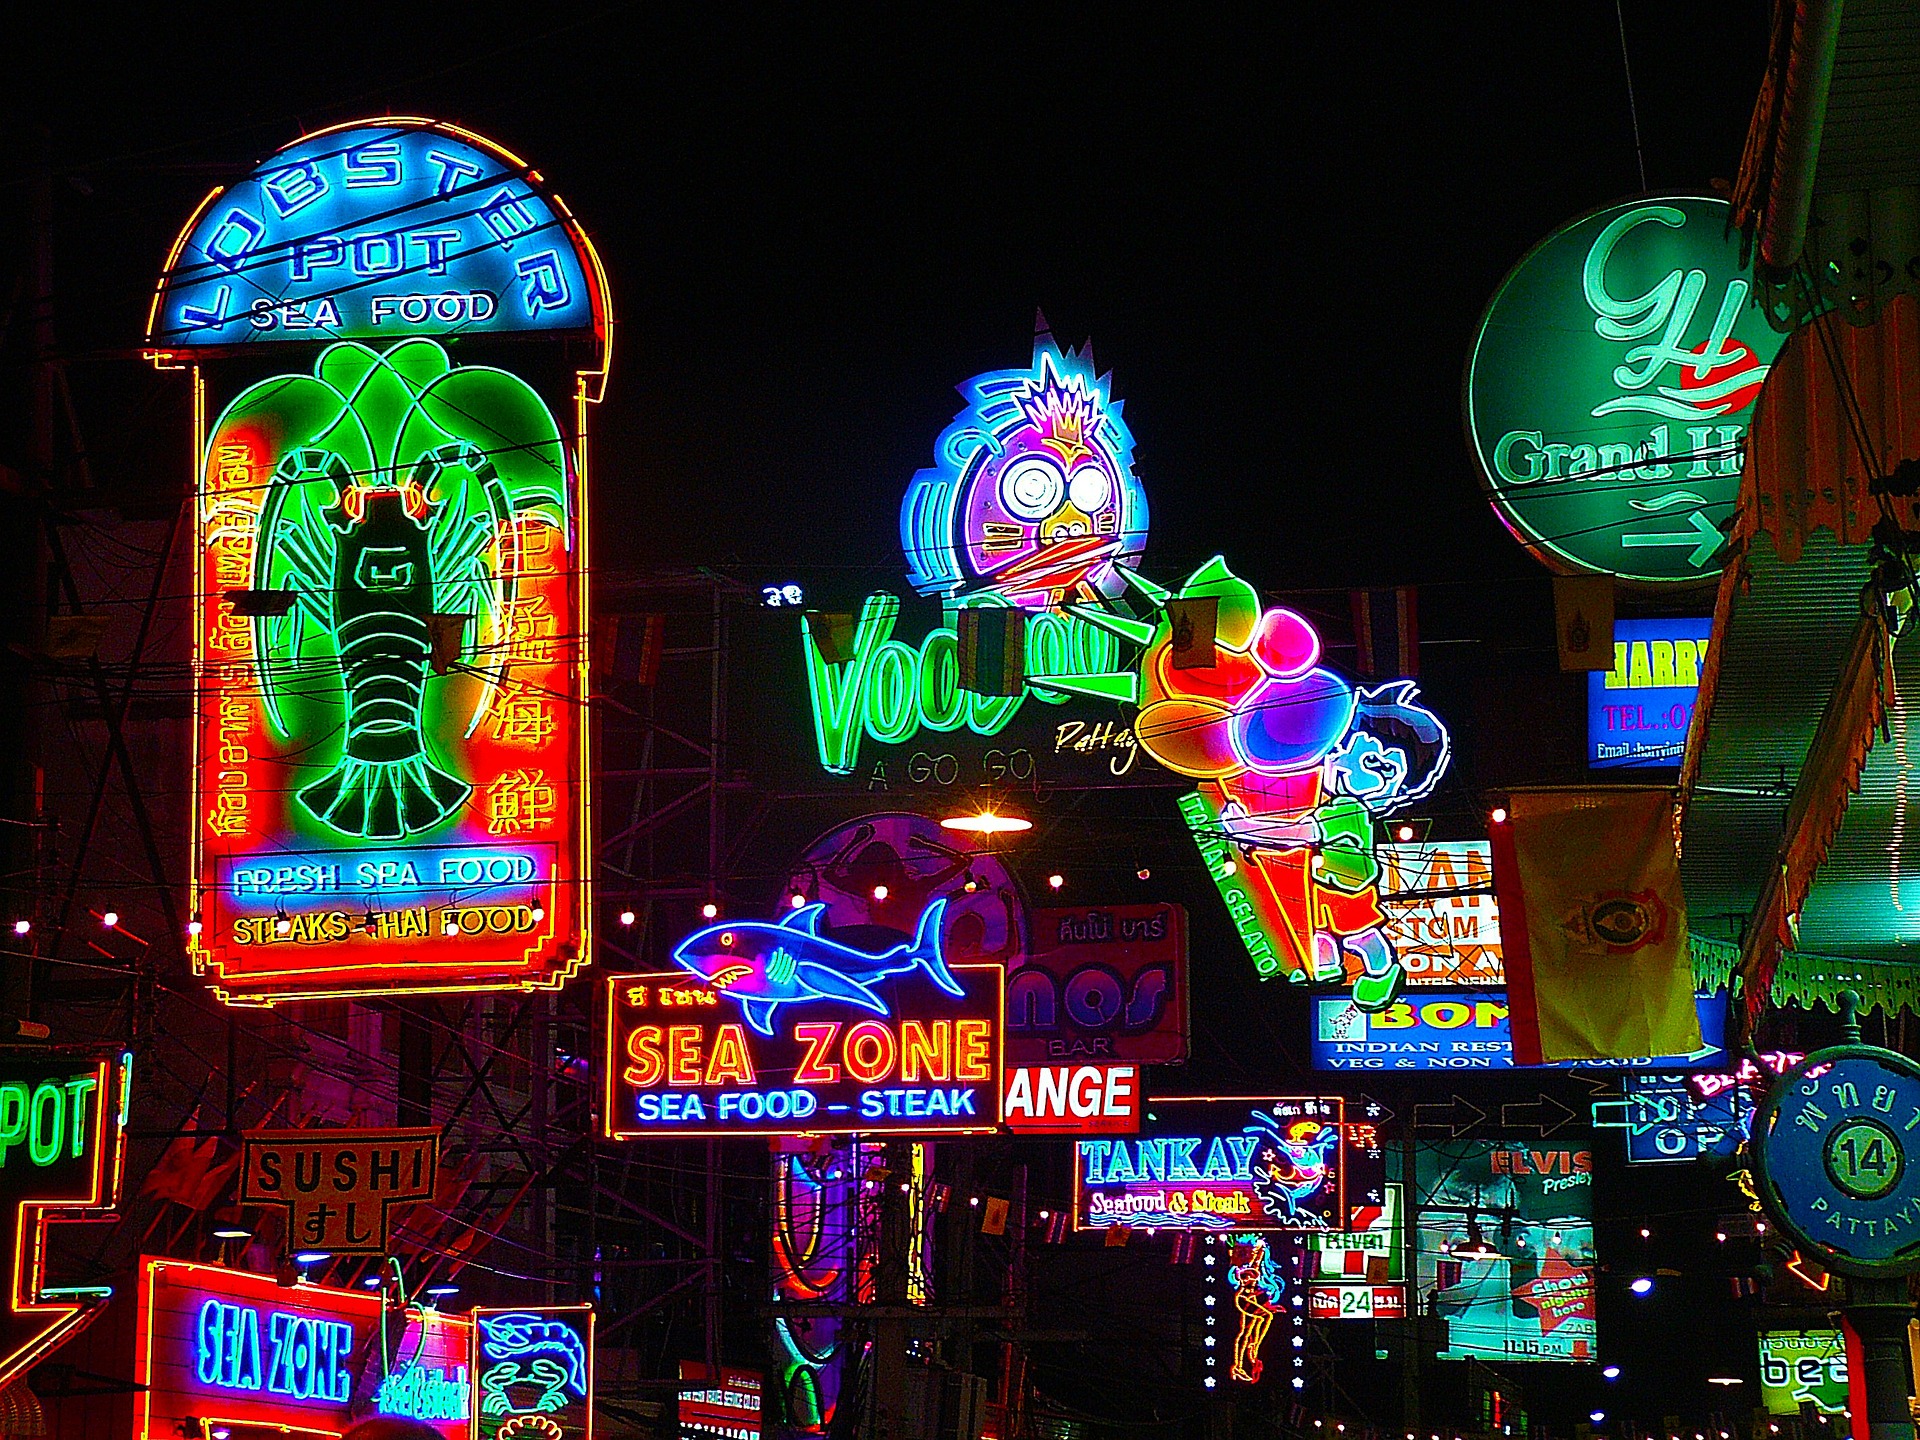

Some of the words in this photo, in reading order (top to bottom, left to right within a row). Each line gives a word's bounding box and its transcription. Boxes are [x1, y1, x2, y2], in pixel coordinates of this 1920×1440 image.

[180, 143, 573, 329] LOBSTER
[290, 230, 462, 282] POT
[250, 298, 342, 329] SEA
[371, 293, 497, 325] FOOD
[1495, 422, 1672, 484] Grand
[869, 761, 889, 790] A
[908, 752, 959, 785] GO
[983, 748, 1036, 782] GO
[233, 863, 340, 895] FRESH
[357, 861, 422, 888] SEA
[439, 855, 537, 884] FOOD
[233, 911, 348, 945] STEAKS
[440, 905, 534, 935] FOOD
[1225, 888, 1279, 976] GELATO
[624, 1023, 756, 1087] SEA
[793, 1018, 991, 1085] ZONE
[1050, 1038, 1109, 1056] BAR
[1328, 1057, 1384, 1069] VEG
[1395, 1057, 1416, 1069] &
[1426, 1056, 1491, 1068] NON
[1336, 1042, 1439, 1054] INDIAN
[637, 1092, 706, 1121] SEA
[718, 1090, 817, 1119] FOOD
[860, 1087, 976, 1118] STEAK
[1005, 1066, 1134, 1118] ANGE
[0, 1077, 97, 1168] POT
[257, 1149, 423, 1193] SUSHI
[1081, 1136, 1260, 1184] TANKAY
[1490, 1150, 1593, 1175] ELVIS
[1841, 1138, 1887, 1176] 14
[1090, 1193, 1166, 1215] Seafood
[1169, 1191, 1189, 1214] &
[1191, 1190, 1252, 1214] Steak
[1543, 1170, 1593, 1196] Presley
[302, 1202, 372, 1245] すし
[1342, 1291, 1371, 1313] 24
[199, 1299, 261, 1391] SEA
[267, 1312, 353, 1403] ZONE
